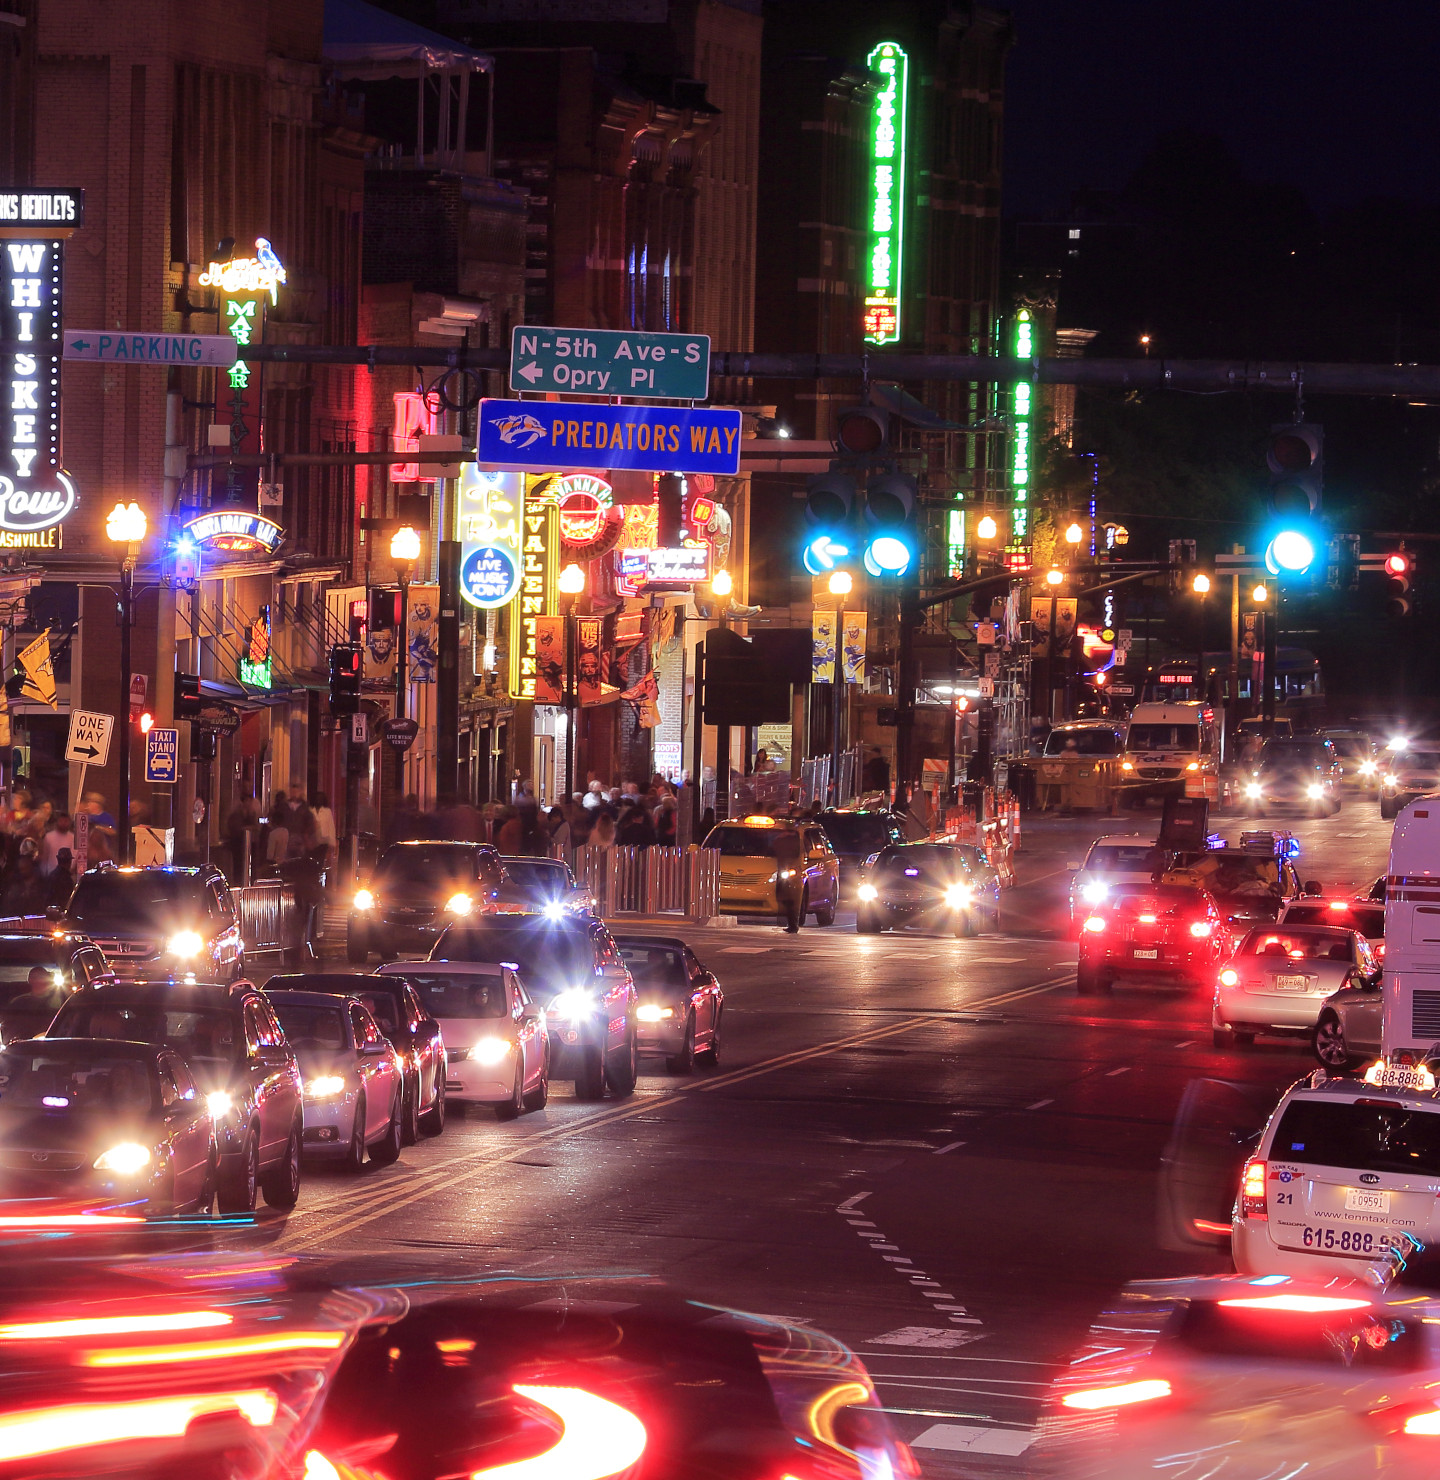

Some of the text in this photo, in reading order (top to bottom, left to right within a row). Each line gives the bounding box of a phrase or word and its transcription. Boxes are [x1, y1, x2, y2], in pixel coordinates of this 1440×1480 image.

[98, 335, 202, 361] PARKING
[7, 244, 46, 477] WHISKEY
[553, 364, 654, 390] Opry Pl
[552, 419, 738, 455] PREDATORS WAY
[255, 521, 278, 544] BAR
[477, 560, 502, 571] LIVE
[469, 572, 509, 584] MUSIC
[471, 583, 507, 596] JOINT
[521, 515, 545, 696] VALENTINE
[581, 632, 598, 640] US
[1160, 675, 1192, 683] RIDE FREE
[78, 715, 104, 731] ONE
[76, 728, 104, 744] WAY
[154, 731, 172, 742] TAXI
[149, 742, 175, 754] STAND
[655, 744, 679, 753] BOOTS
[1136, 754, 1184, 763] FedEx
[1374, 1069, 1425, 1086] 888-8888
[1361, 1174, 1378, 1183] KIA
[1276, 1192, 1293, 1205] 21
[1358, 1195, 1384, 1208] 09591
[1313, 1210, 1417, 1227] www.tenntaxi.com
